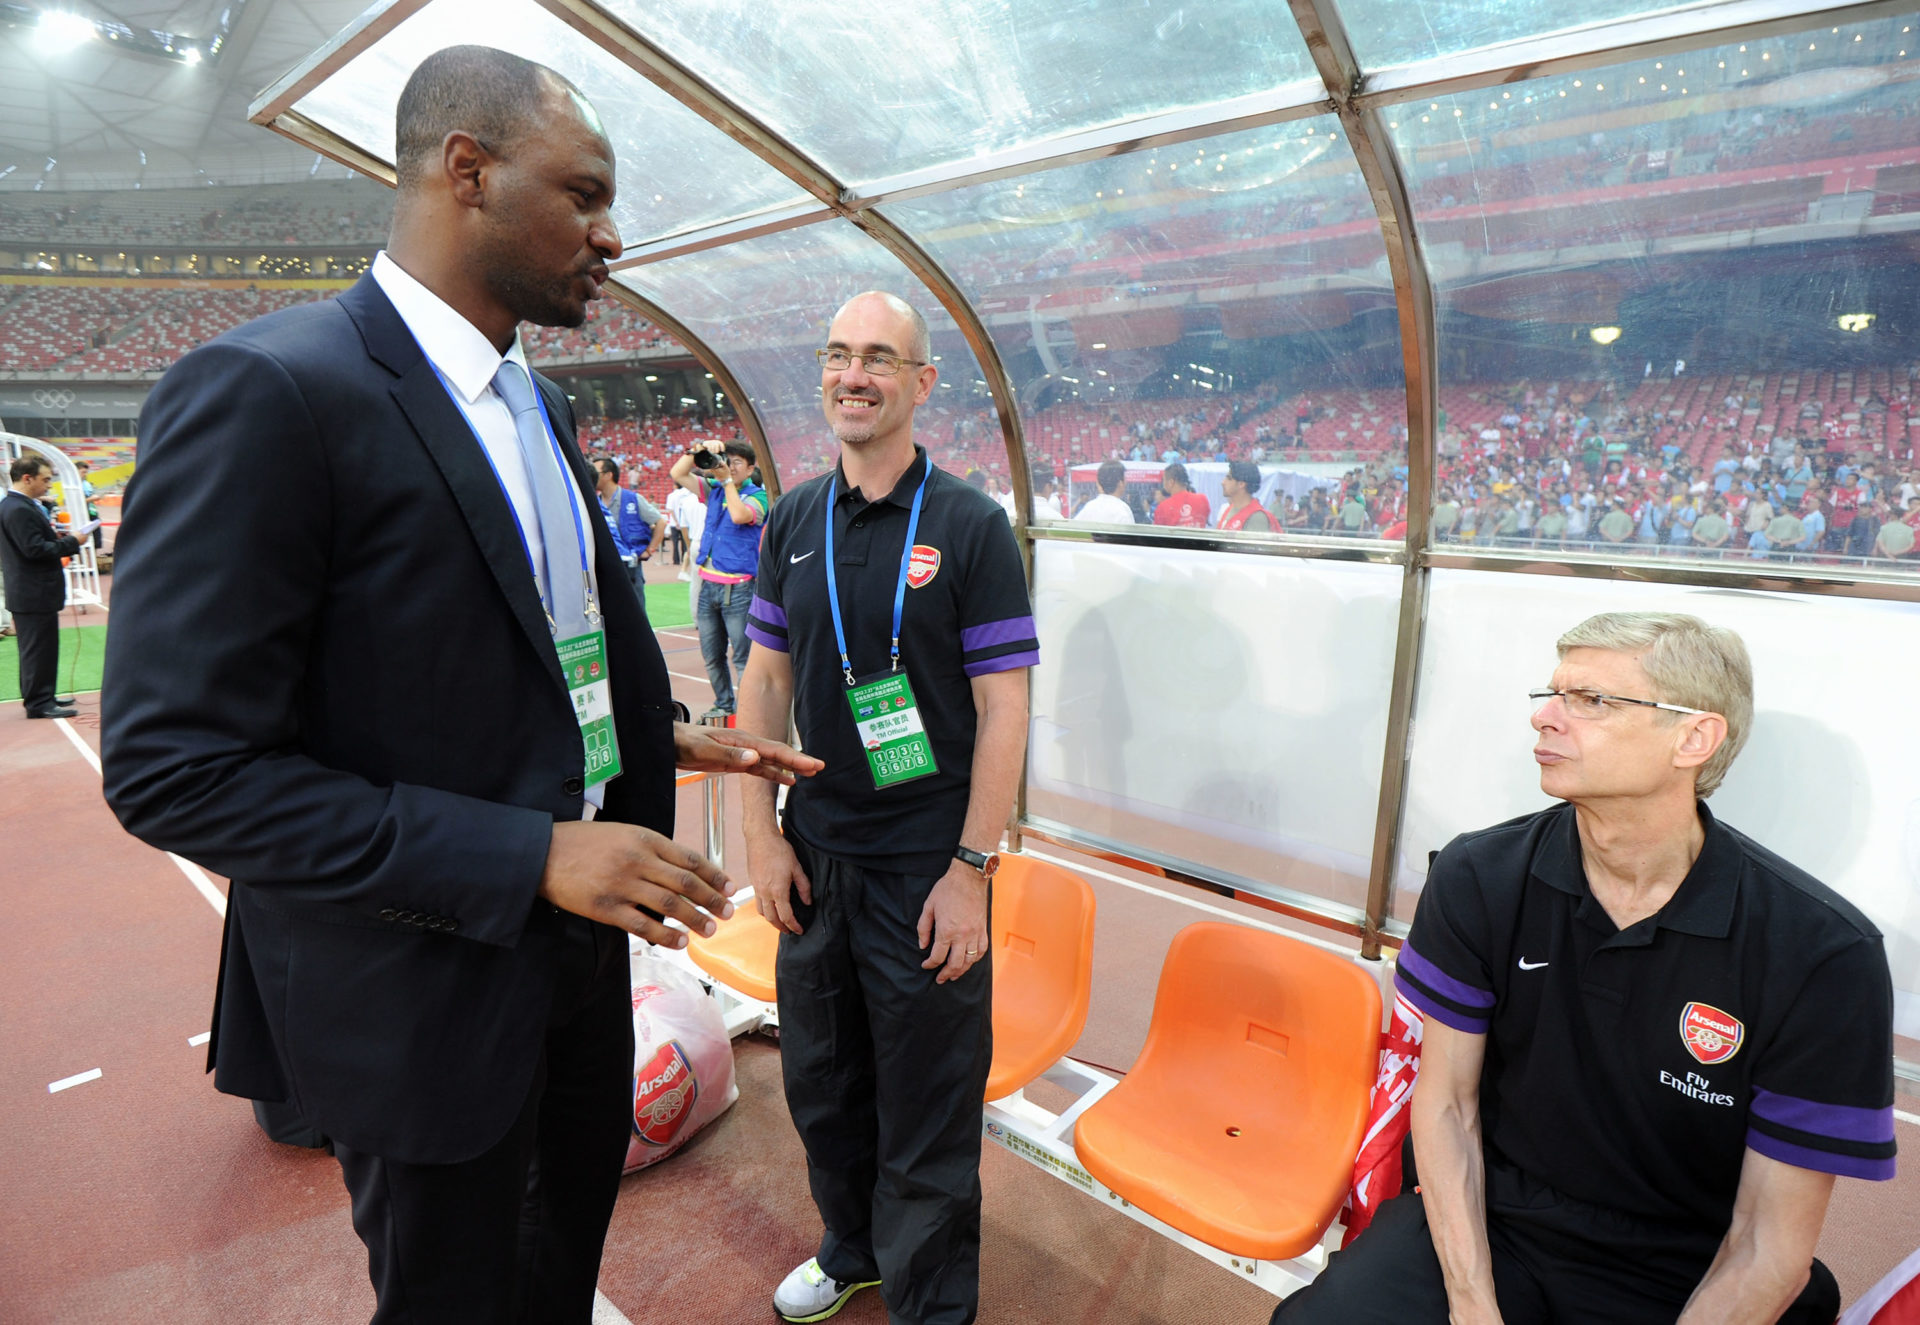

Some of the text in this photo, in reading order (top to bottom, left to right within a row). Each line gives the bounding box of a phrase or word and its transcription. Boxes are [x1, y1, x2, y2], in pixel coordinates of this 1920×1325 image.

[869, 713, 909, 732] 参赛队官员
[876, 726, 908, 740] TM Official
[1690, 1011, 1735, 1035] Arsenal
[638, 1053, 682, 1100] Arsenal
[1686, 1071, 1710, 1090] Fly
[1660, 1070, 1735, 1106] Emirates
